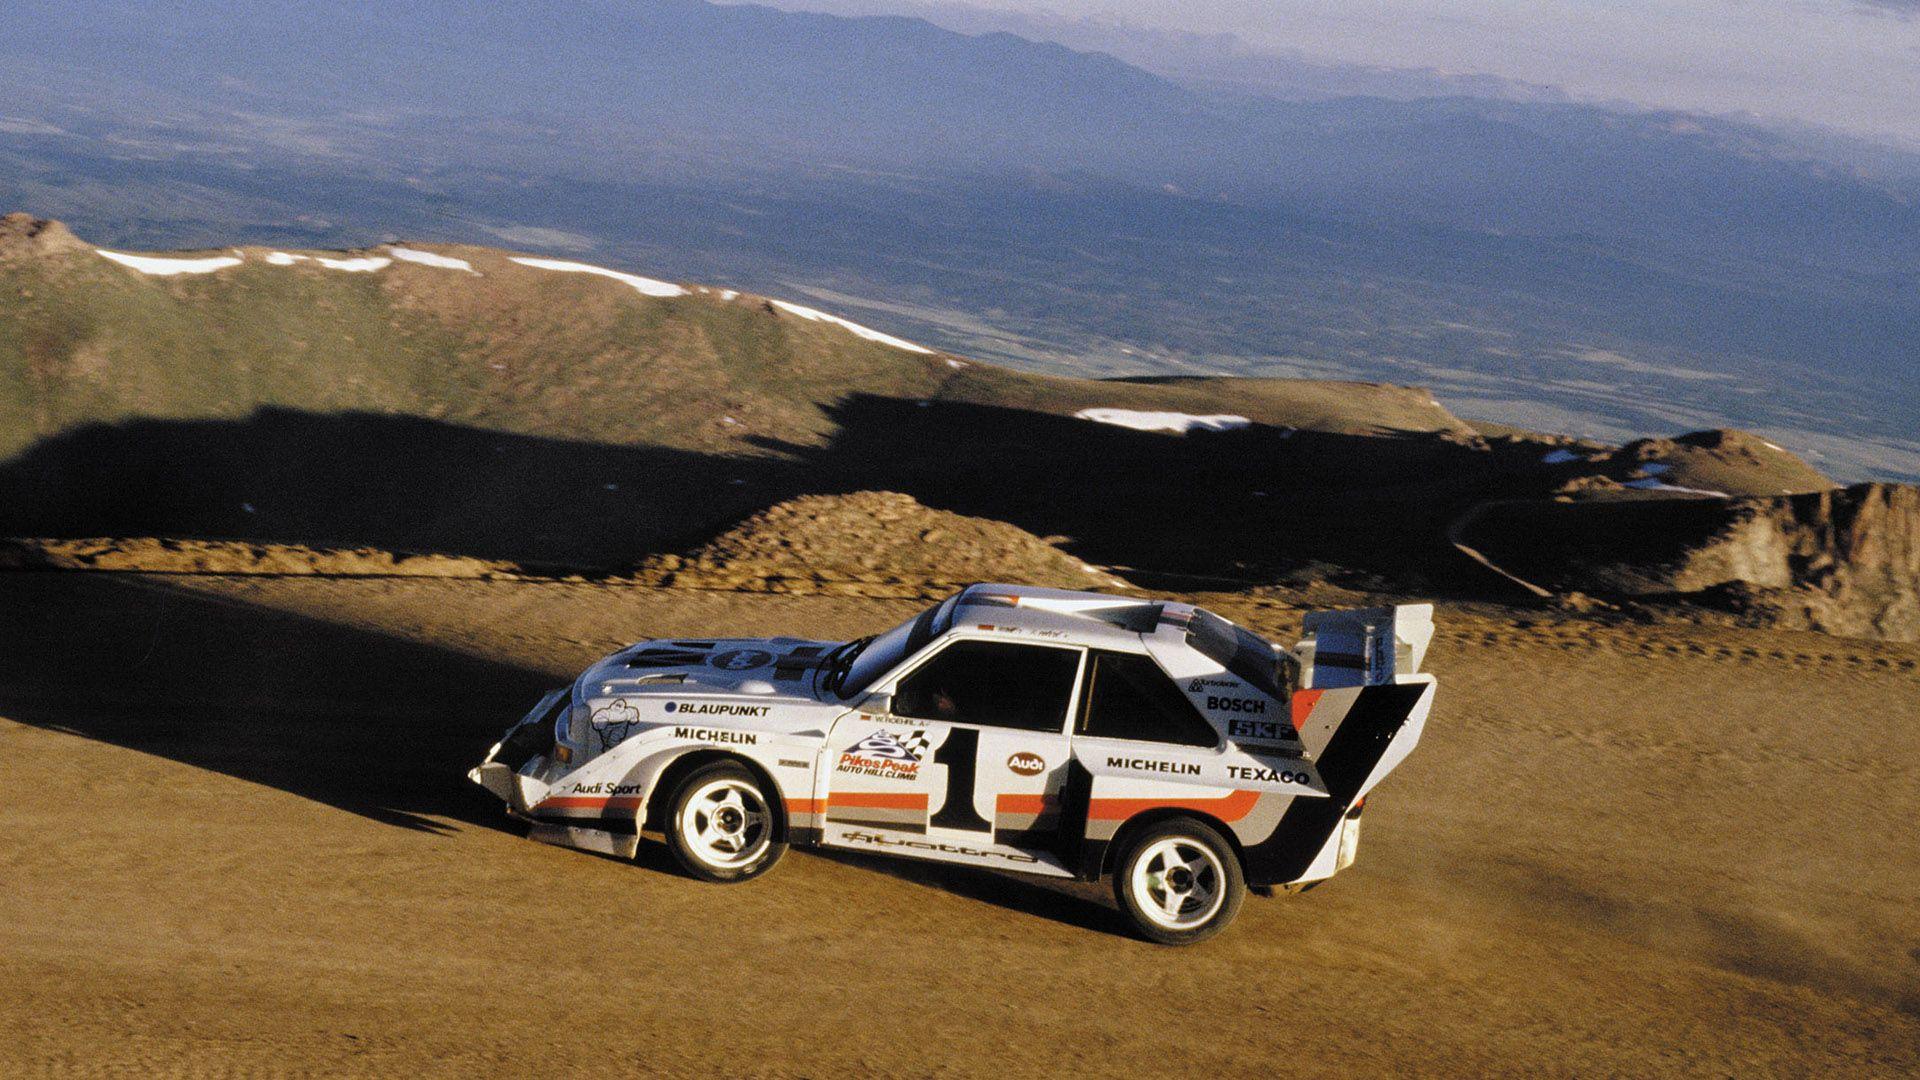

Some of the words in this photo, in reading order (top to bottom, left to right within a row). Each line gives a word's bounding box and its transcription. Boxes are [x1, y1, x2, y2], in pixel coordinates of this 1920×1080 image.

[678, 703, 771, 717] BLAUPUNKT
[1207, 696, 1265, 713] BOSCH
[674, 727, 757, 745] MICHELIN
[1235, 722, 1293, 740] SKF
[836, 765, 862, 774] AUTO
[840, 753, 880, 769] Pikes
[881, 759, 919, 773] Peak
[1009, 756, 1044, 770] Audi
[1107, 757, 1201, 775] MICHELIN
[930, 727, 992, 833] 1
[1227, 766, 1310, 785] TEXACO
[572, 783, 601, 794] Audi
[605, 783, 641, 796] Sport
[841, 831, 1039, 864] quattro
